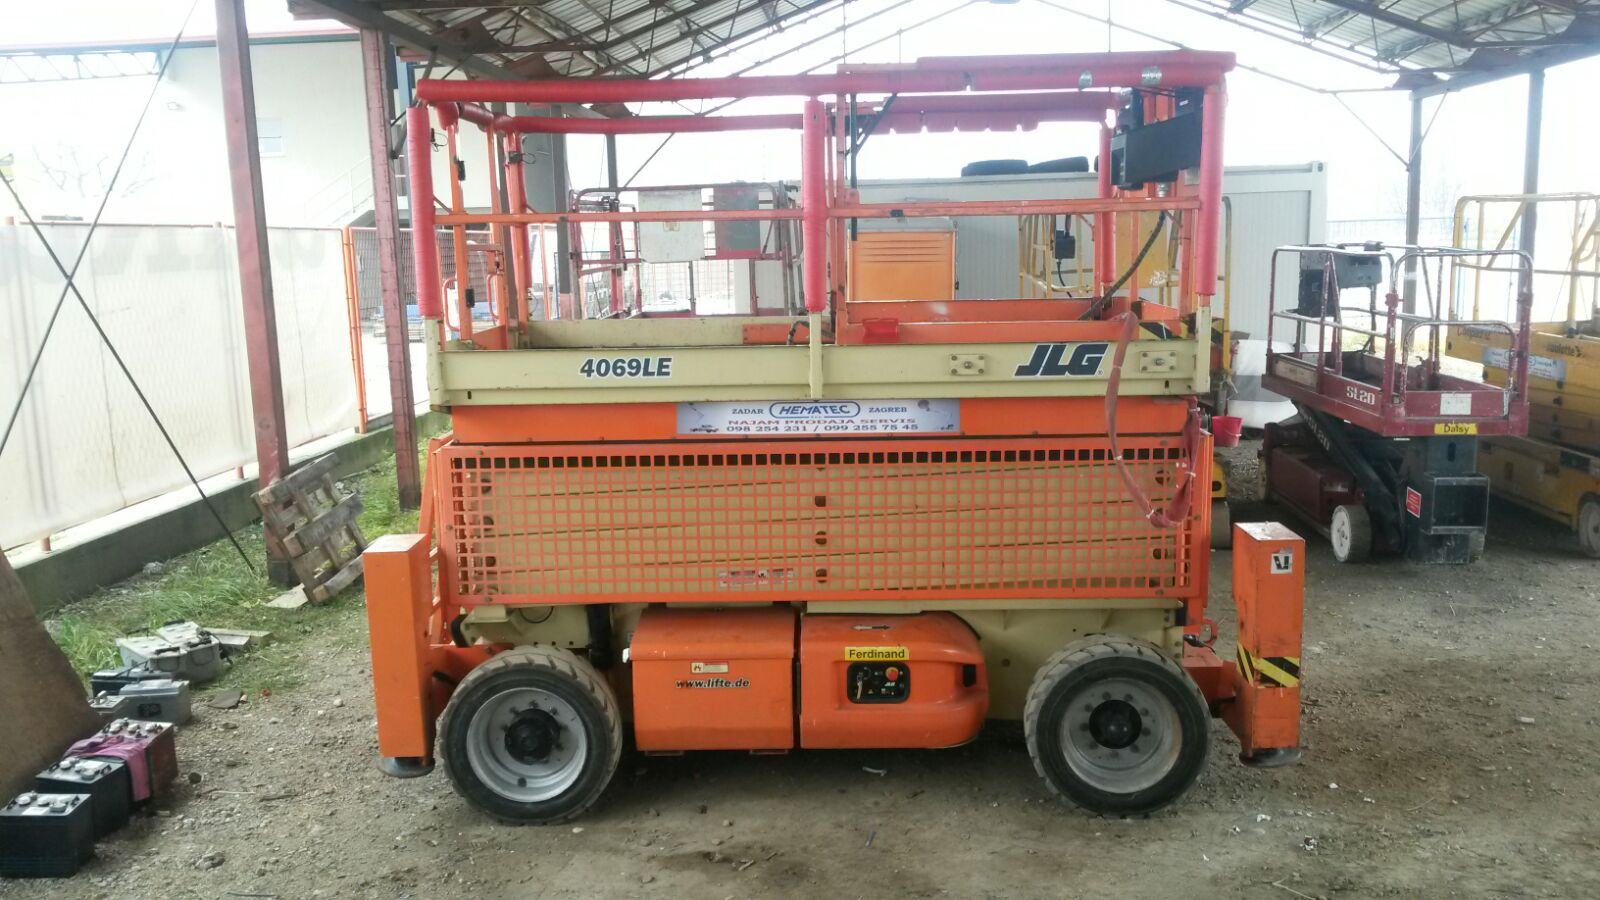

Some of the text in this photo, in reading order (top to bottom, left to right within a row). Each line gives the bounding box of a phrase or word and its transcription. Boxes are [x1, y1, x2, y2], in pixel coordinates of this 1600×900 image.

[1014, 343, 1109, 377] JLG
[579, 357, 673, 378] 4069LE
[1346, 385, 1376, 405] SL20
[778, 404, 851, 415] HEMATEC
[1443, 423, 1470, 435] Daisy
[849, 649, 905, 659] Ferdinand
[676, 678, 750, 688] www.lifte.de
